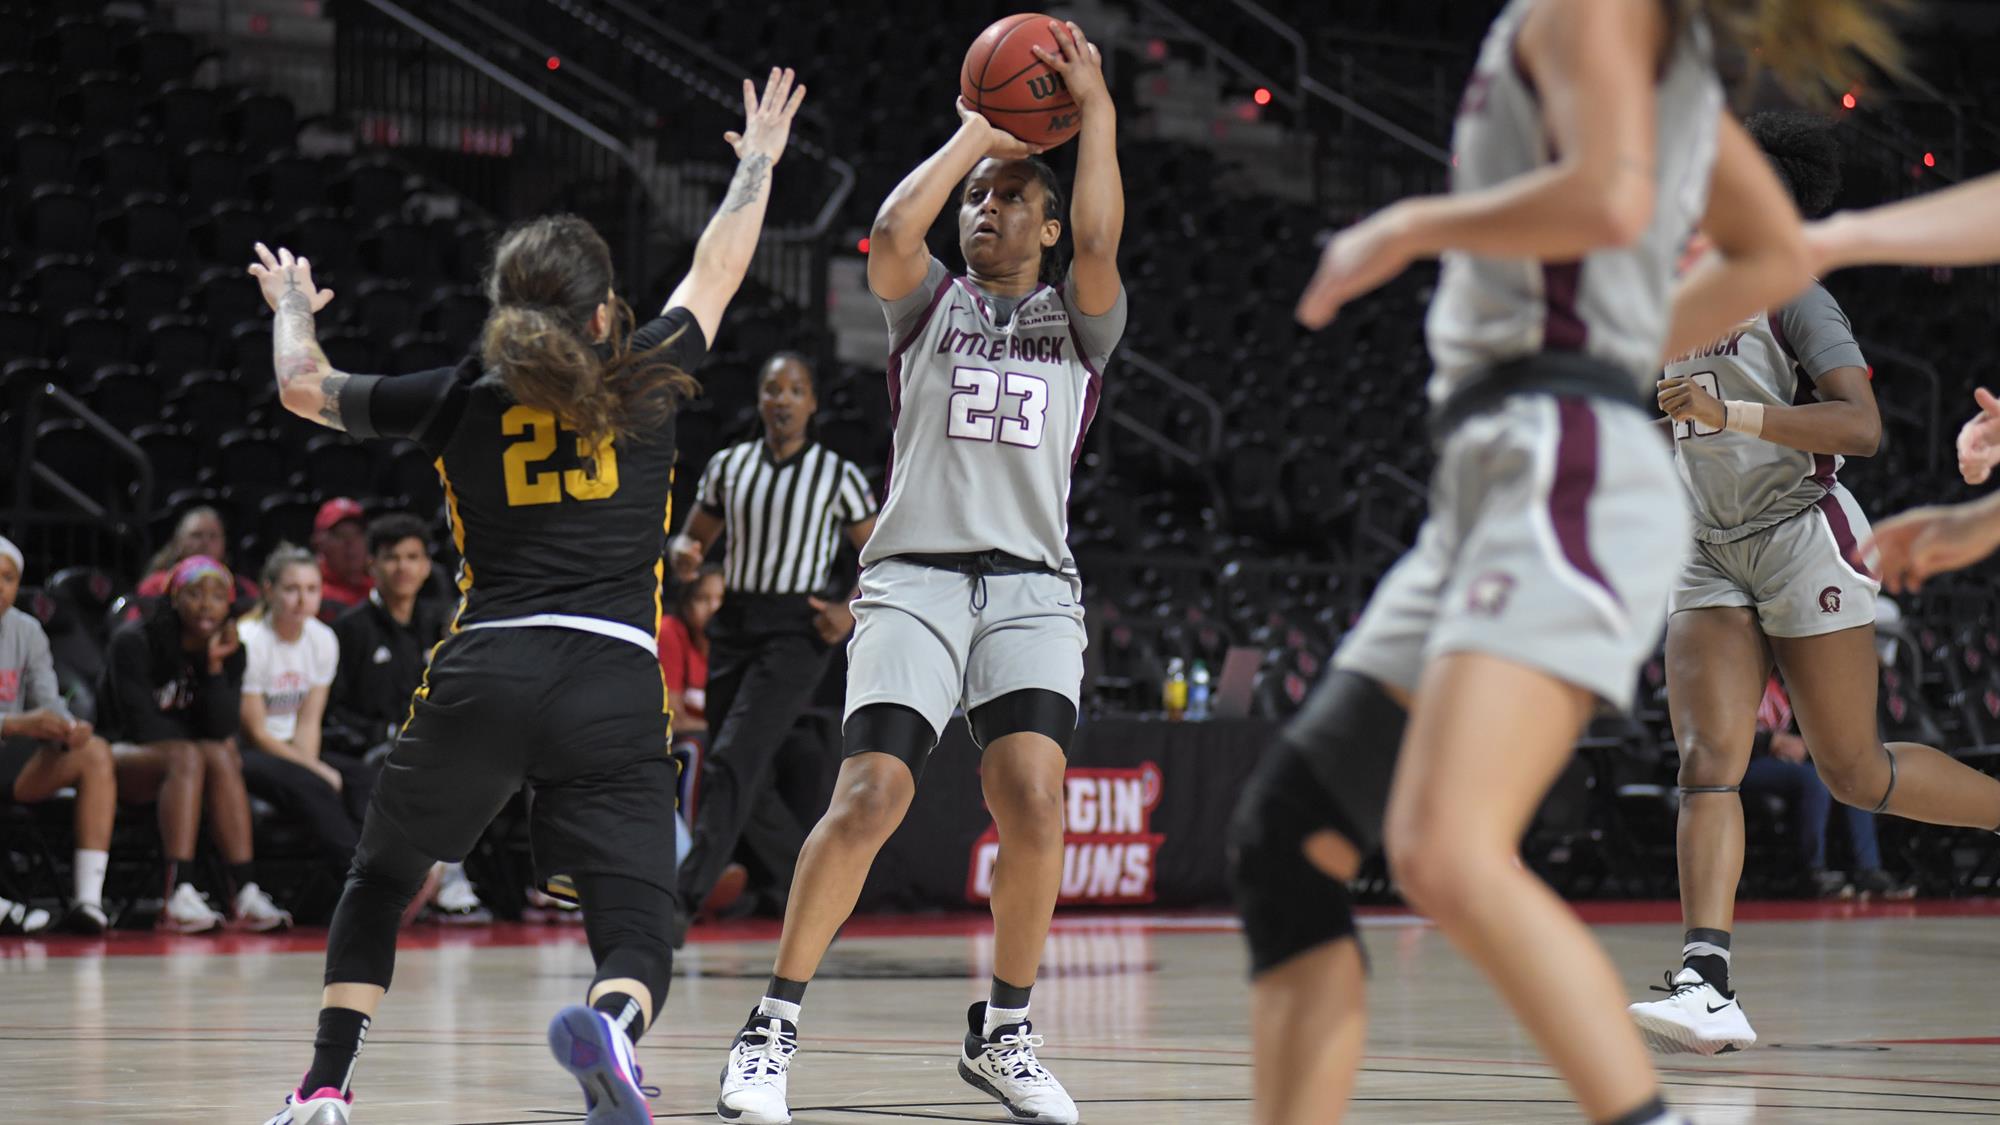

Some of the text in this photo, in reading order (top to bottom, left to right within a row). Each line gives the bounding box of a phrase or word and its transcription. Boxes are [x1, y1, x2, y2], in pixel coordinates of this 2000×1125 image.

[1043, 313, 1066, 322] BELT
[937, 327, 1066, 365] LITTLE ROCK
[947, 366, 1048, 449] 23
[502, 405, 620, 506] 23
[1061, 777, 1143, 834] GIN
[974, 842, 1150, 897] CUNS
